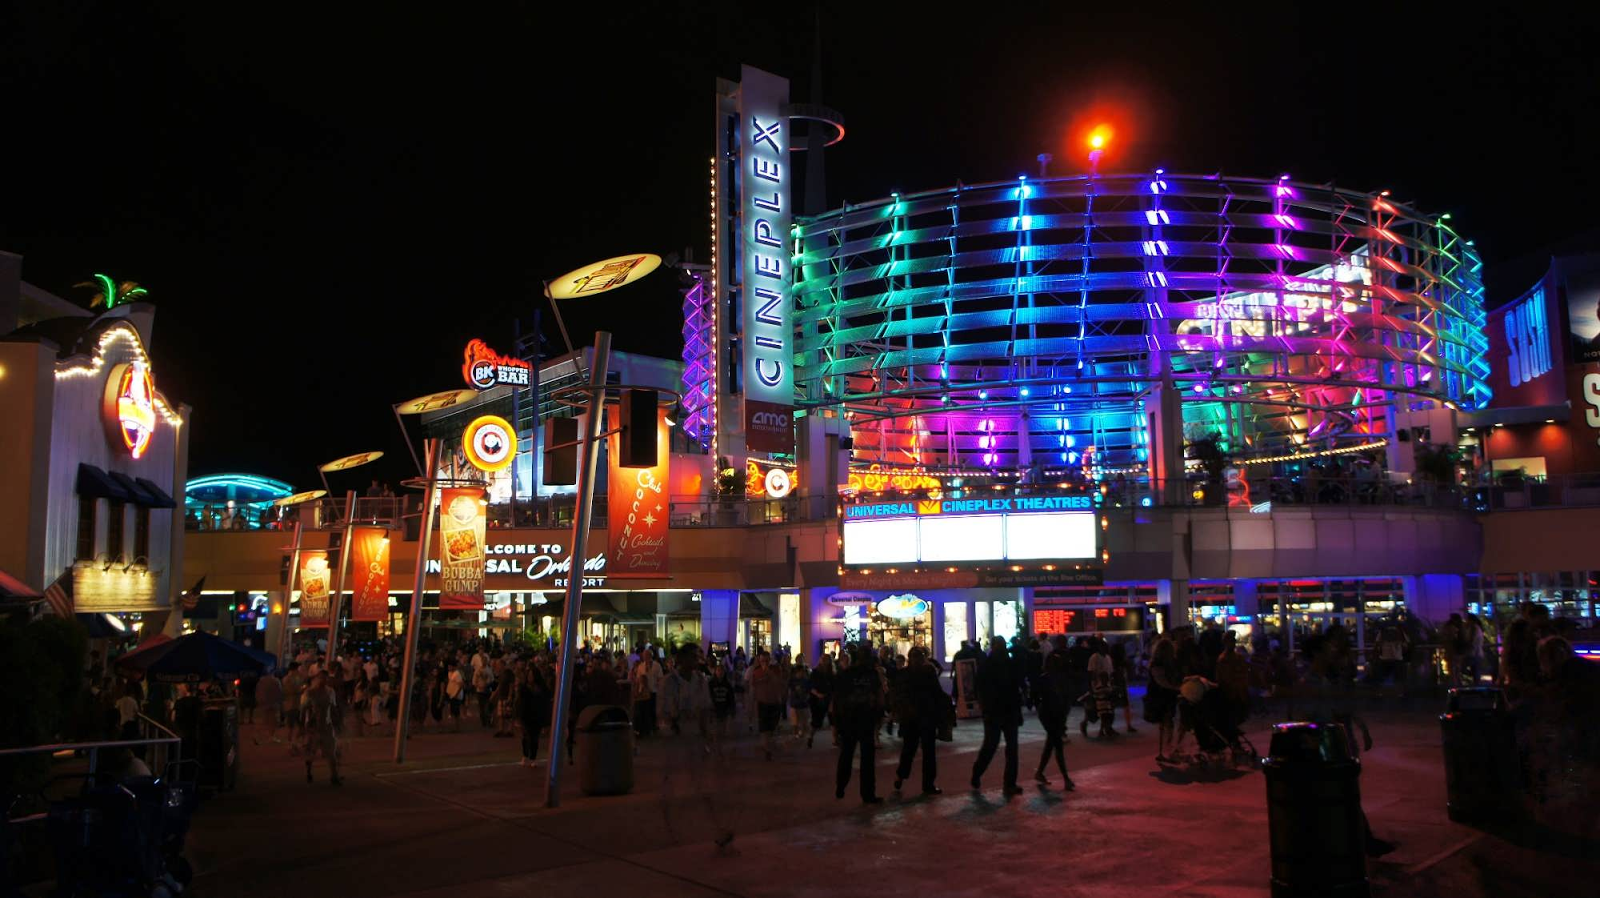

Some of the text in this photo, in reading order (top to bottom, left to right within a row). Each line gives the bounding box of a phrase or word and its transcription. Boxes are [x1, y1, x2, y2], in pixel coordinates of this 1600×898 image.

[752, 115, 783, 388] CINEPLEX
[475, 364, 495, 381] BK
[497, 365, 529, 374] WHOPPER
[498, 371, 529, 385] BAR
[846, 497, 1091, 517] UNIVERSAL CINEPLEX THEATRES
[484, 544, 562, 554] LCOME TO
[443, 567, 482, 579] BUBBA
[446, 580, 478, 592] GUMP
[554, 578, 604, 587] REORT
